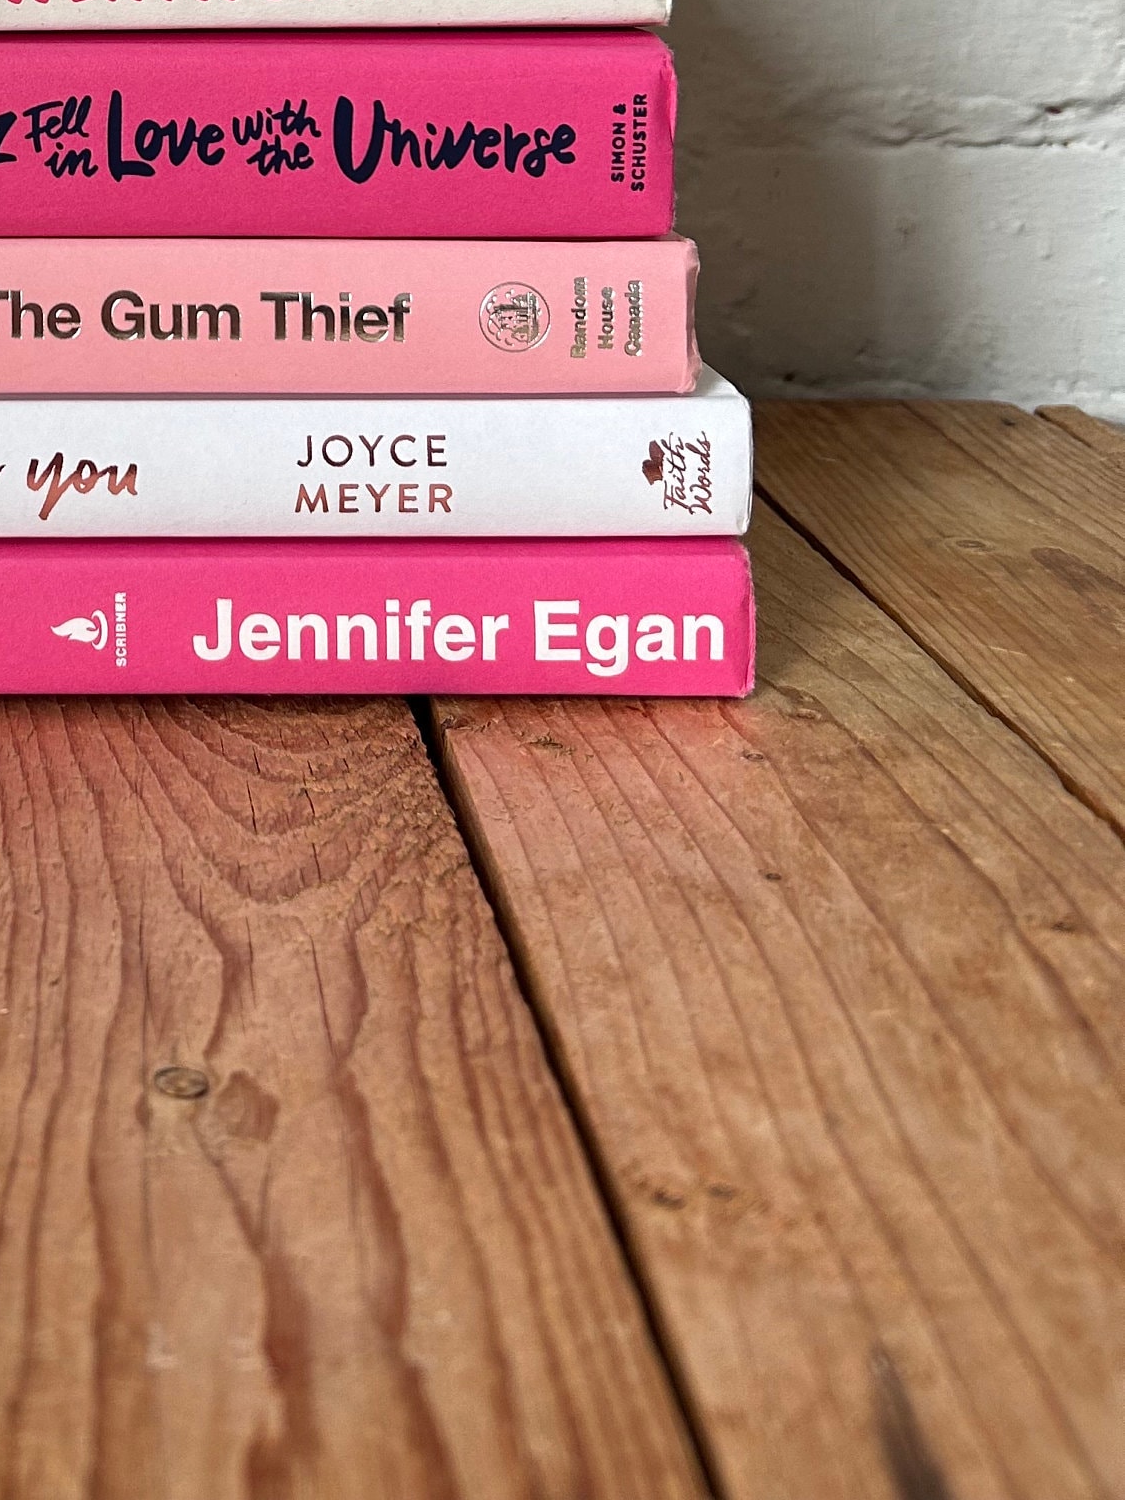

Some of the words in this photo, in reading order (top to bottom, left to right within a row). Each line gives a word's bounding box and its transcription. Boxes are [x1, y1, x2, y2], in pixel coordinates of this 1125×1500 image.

[23, 96, 93, 140] Fell
[108, 90, 225, 182] Love
[232, 99, 322, 142] with
[333, 96, 576, 184] Universe
[613, 104, 626, 114] &
[44, 146, 98, 179] in
[248, 136, 315, 177] the
[610, 124, 626, 183] SIMON
[631, 94, 647, 191] SCHUSTER
[101, 290, 240, 340] Gum
[261, 292, 410, 341] Thief
[570, 277, 587, 358] Random
[598, 287, 615, 349] House
[624, 281, 643, 356] Canada
[297, 435, 447, 467] JOYCE
[661, 432, 688, 510] Faith
[685, 431, 712, 515] Words
[27, 452, 137, 520] you
[295, 484, 452, 513] MEYER
[115, 593, 126, 666] SCRIBNER
[193, 599, 509, 661] Jennifer
[534, 600, 723, 676] Egan
